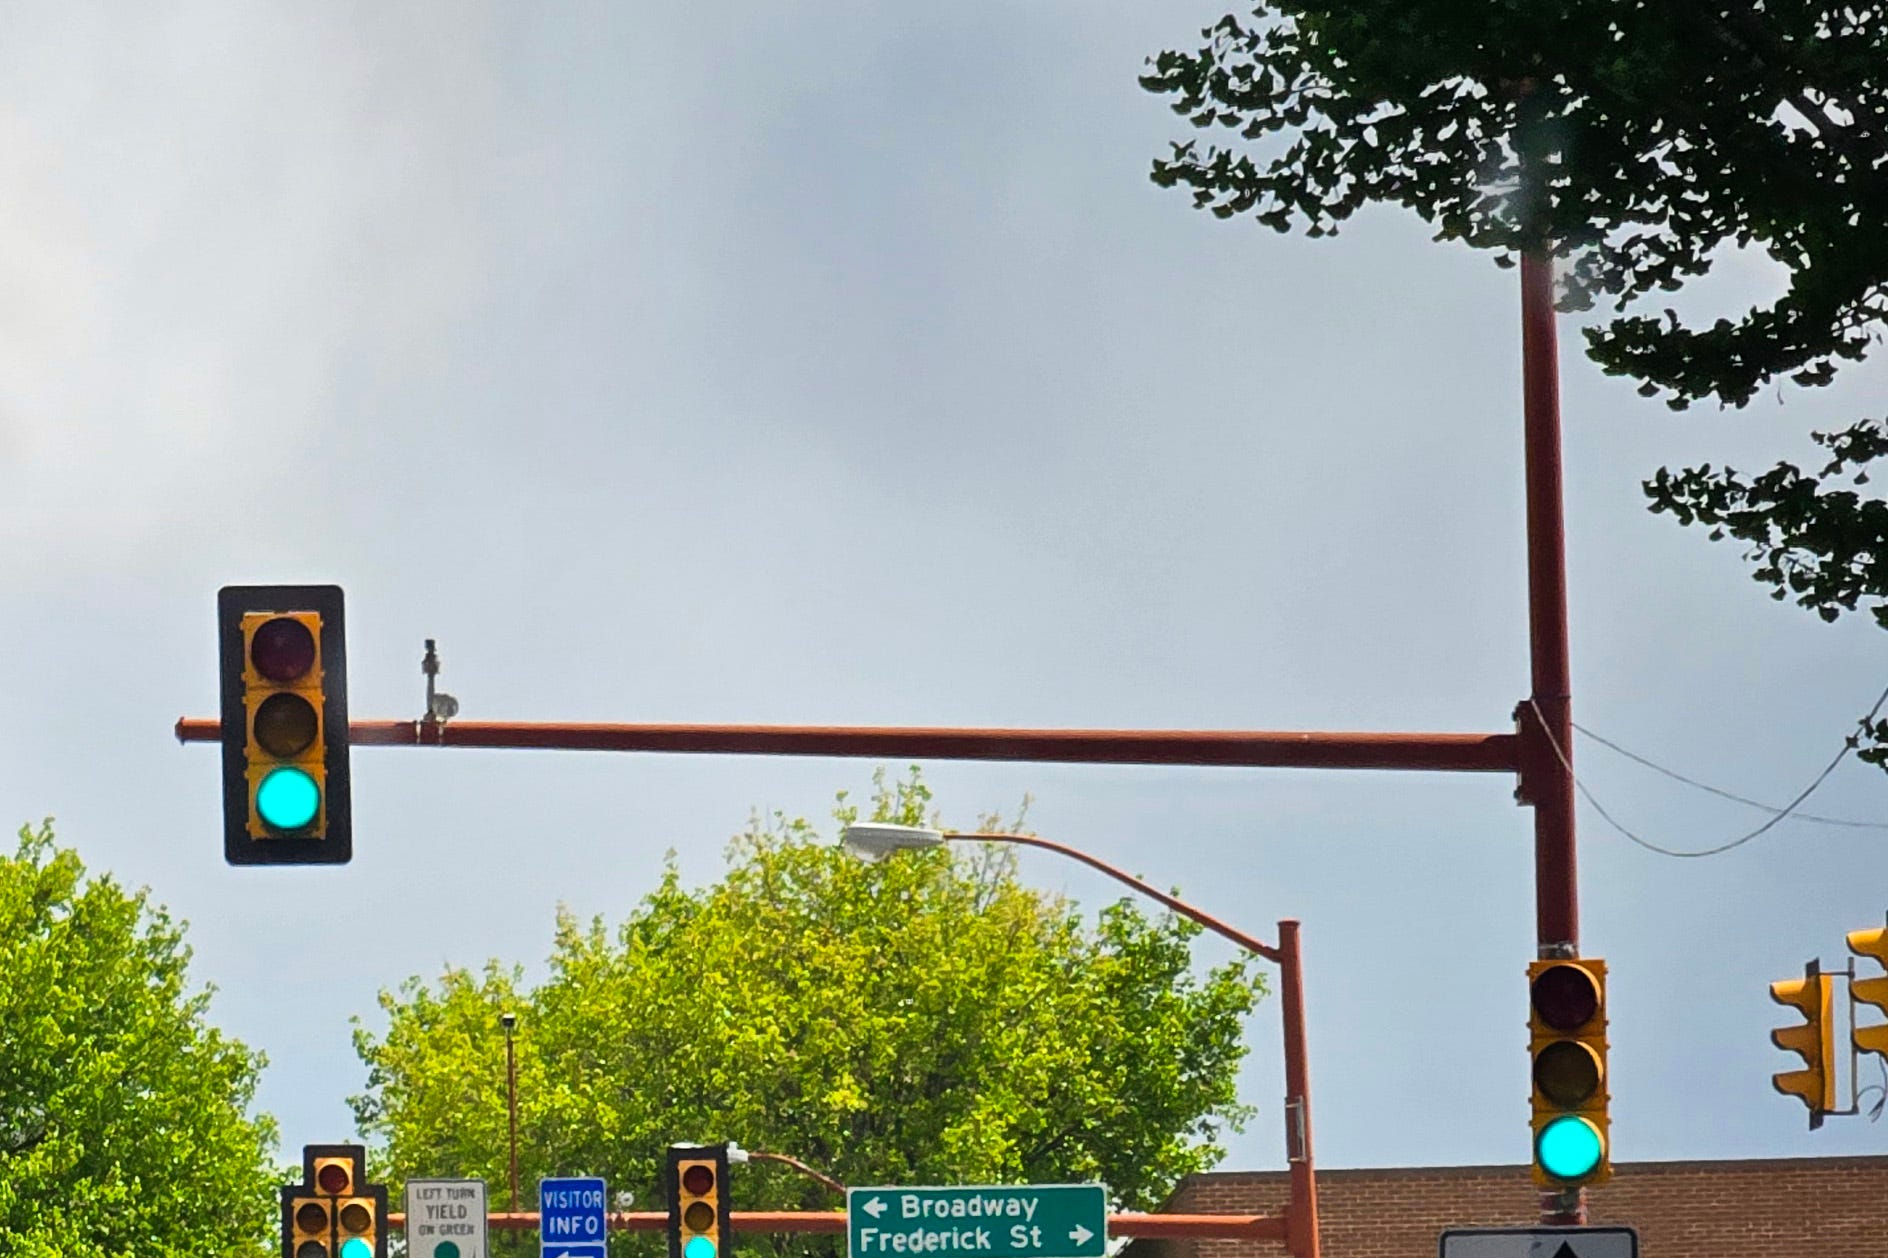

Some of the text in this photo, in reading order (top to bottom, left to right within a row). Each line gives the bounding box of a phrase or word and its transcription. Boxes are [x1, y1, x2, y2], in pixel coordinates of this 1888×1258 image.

[416, 1187, 476, 1200] LEFT TURN
[543, 1190, 603, 1209] VISITOR
[425, 1204, 468, 1220] YIELD
[900, 1193, 1040, 1222] Broadway
[418, 1224, 475, 1236] ON GREEN
[548, 1215, 599, 1235] INFO
[860, 1224, 1043, 1254] Frederick St
